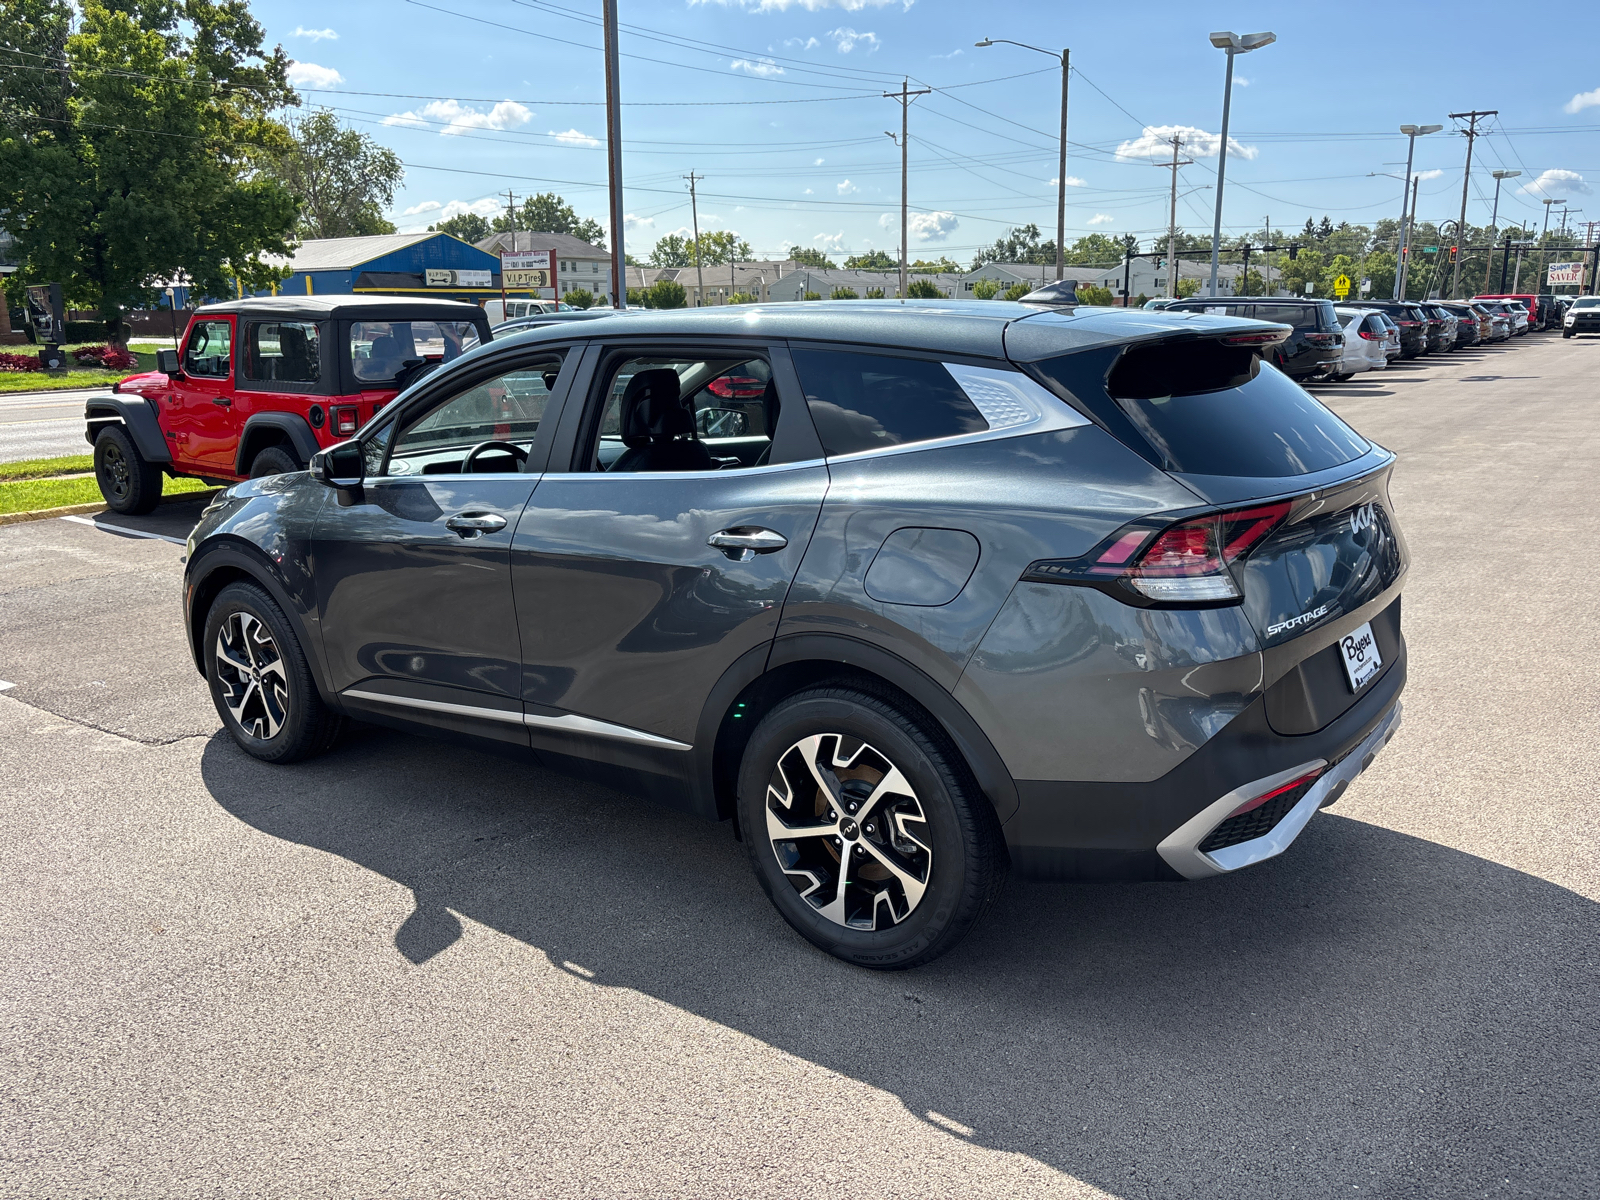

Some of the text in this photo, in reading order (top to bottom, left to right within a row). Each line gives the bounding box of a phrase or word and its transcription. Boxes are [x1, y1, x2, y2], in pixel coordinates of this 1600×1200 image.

[1550, 264, 1570, 272] Super
[524, 273, 541, 282] Tires
[1550, 273, 1577, 281] SAVER
[1267, 605, 1327, 635] SPORTAGE
[1342, 633, 1372, 663] Byers
[852, 952, 898, 962] SEASON
